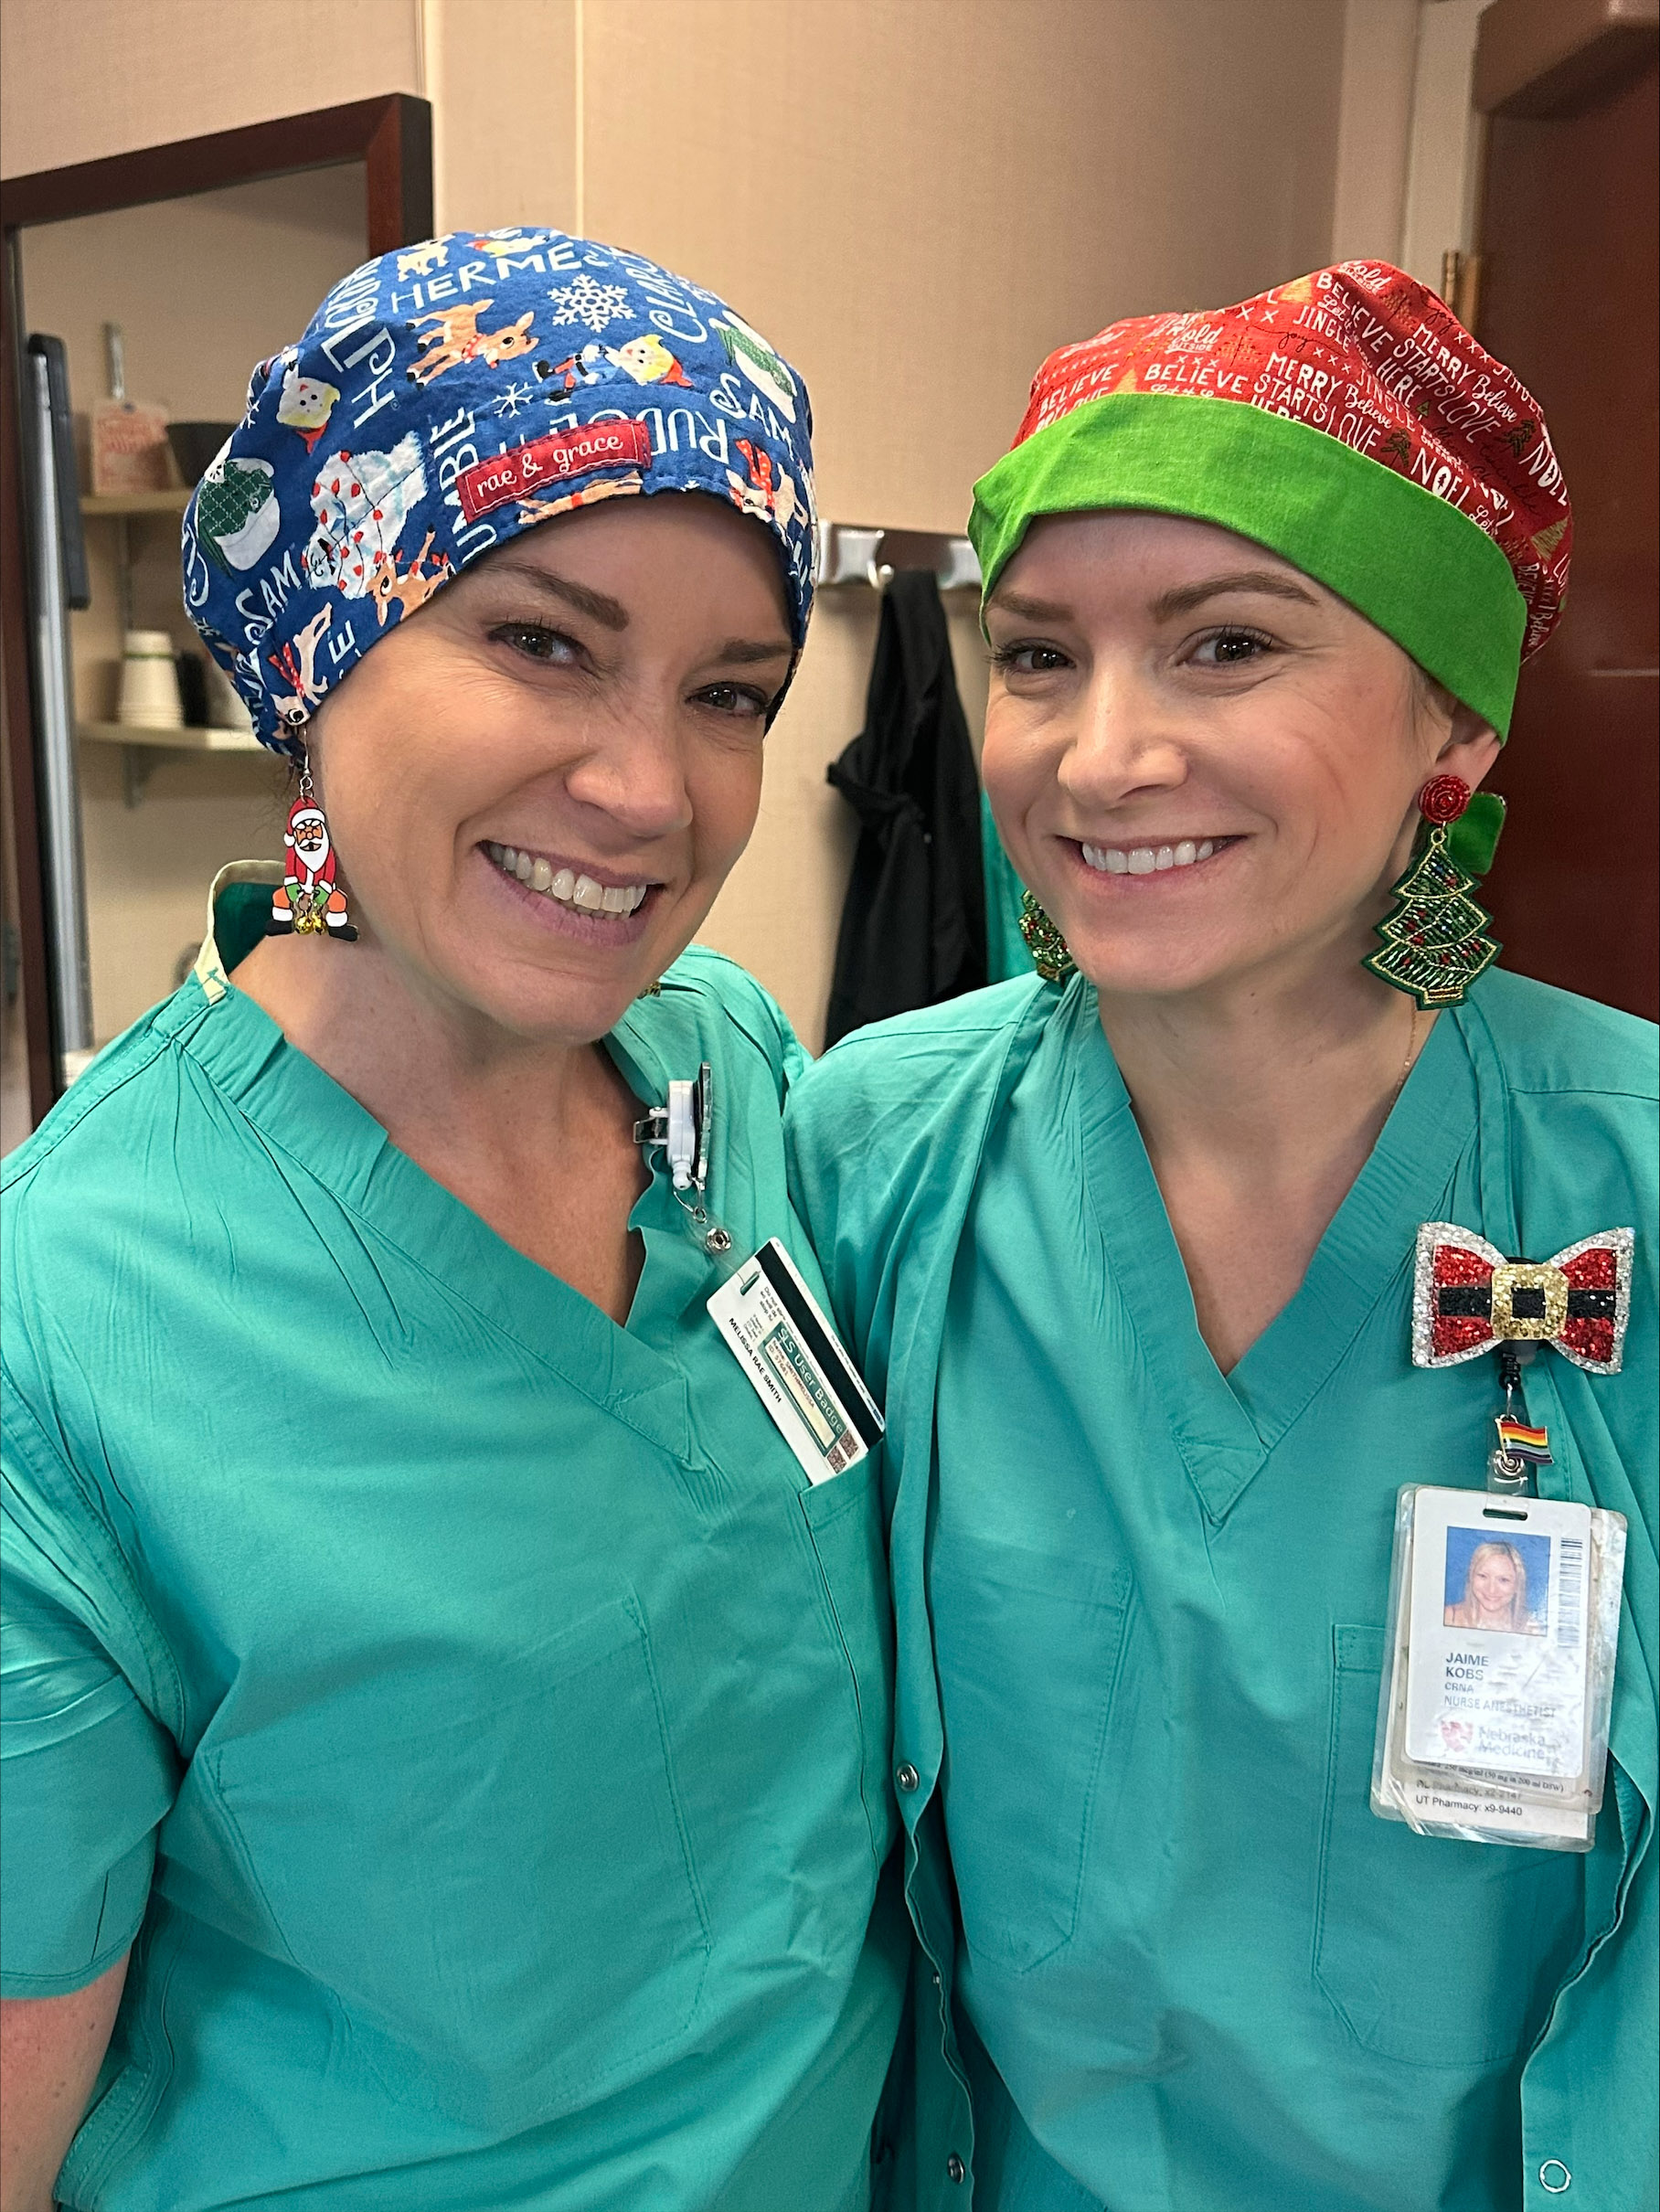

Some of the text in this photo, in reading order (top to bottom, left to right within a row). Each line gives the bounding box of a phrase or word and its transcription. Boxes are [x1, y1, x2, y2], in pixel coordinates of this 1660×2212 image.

[1293, 304, 1351, 354] JINGLE
[1316, 271, 1394, 353] BELIEVE
[1393, 338, 1455, 397] STARTS
[1038, 364, 1120, 420] BELIEVE
[1144, 363, 1249, 394] BELIEVE
[1253, 373, 1328, 423] STARTS
[1265, 351, 1392, 429] MERRY Believe
[1376, 357, 1422, 408] HERE
[1413, 323, 1476, 385] MERRY
[1472, 374, 1517, 422] Believe
[709, 373, 795, 461] SAM
[1356, 368, 1415, 432] JINGLE
[1438, 390, 1501, 443] LOVE
[477, 431, 624, 498] rae & grace
[235, 548, 303, 645] SAM
[729, 1317, 753, 1357] MELISSA
[752, 1356, 766, 1375] RAE
[763, 1375, 782, 1403] SMITH
[779, 1327, 844, 1434] SLS User Badge
[1445, 1652, 1489, 1667] JAIME
[1445, 1667, 1484, 1681] KOBS
[1444, 1682, 1474, 1693] CRNA
[1444, 1696, 1481, 1709] NURSE
[1477, 1740, 1546, 1760] Medicine
[1478, 1726, 1546, 1746] Nebraska
[1415, 1795, 1429, 1805] UT
[1484, 1805, 1523, 1816] x9-9440
